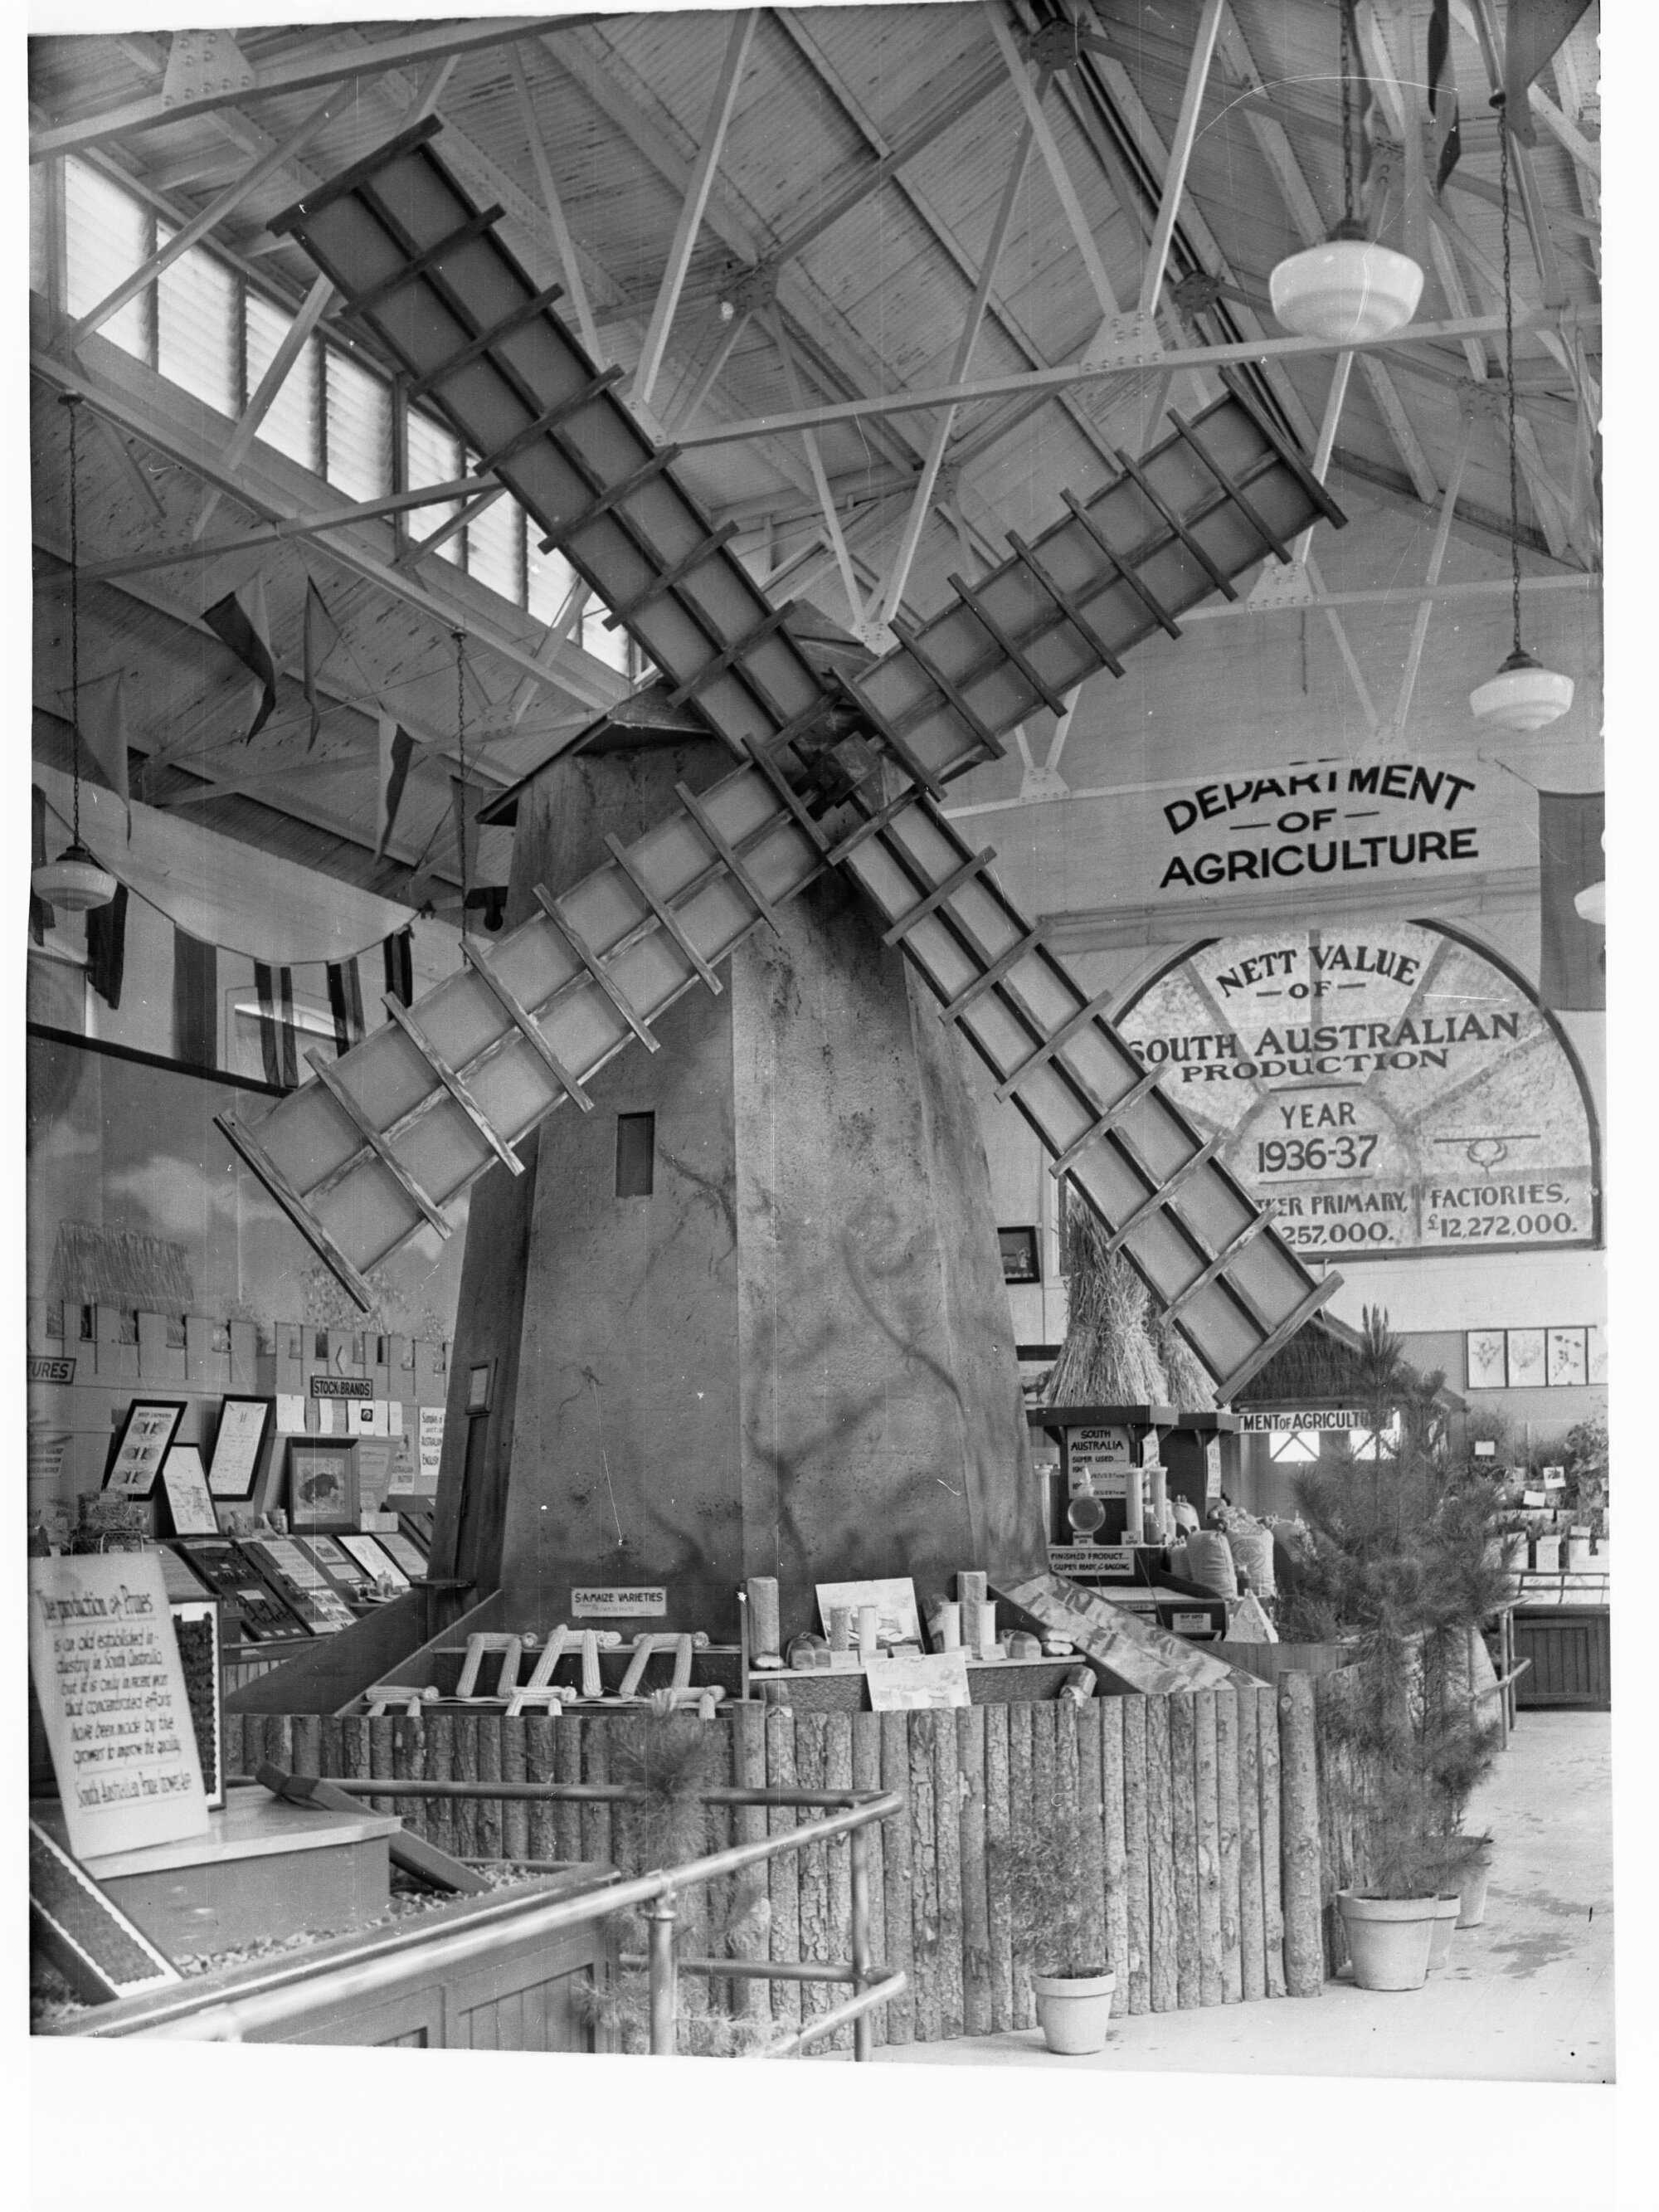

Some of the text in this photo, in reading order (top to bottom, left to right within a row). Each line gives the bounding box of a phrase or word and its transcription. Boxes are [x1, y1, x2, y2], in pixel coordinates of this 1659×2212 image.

[1163, 758, 1476, 835] DEPARTMENT
[1277, 808, 1337, 833] OF
[1160, 828, 1478, 889] AGRICULTURE
[1216, 944, 1420, 997] NETT VALUE
[1288, 981, 1332, 1000] OF
[1129, 1012, 1520, 1065] SOUTH AUSTRALIAN
[1182, 1049, 1449, 1083] PRODUCTION
[1281, 1101, 1356, 1130] YEAR
[1258, 1134, 1379, 1173] 1936-37
[1311, 1191, 1408, 1215] PRIMARY,
[1431, 1183, 1570, 1208] FACTORIES,
[30, 1362, 69, 1379] URES
[314, 1380, 370, 1396] STOCK BRANDS
[1070, 1440, 1125, 1451] AUSTRALIA
[1080, 1430, 1112, 1440] SOUTH
[617, 1591, 664, 1603] VARIETIES
